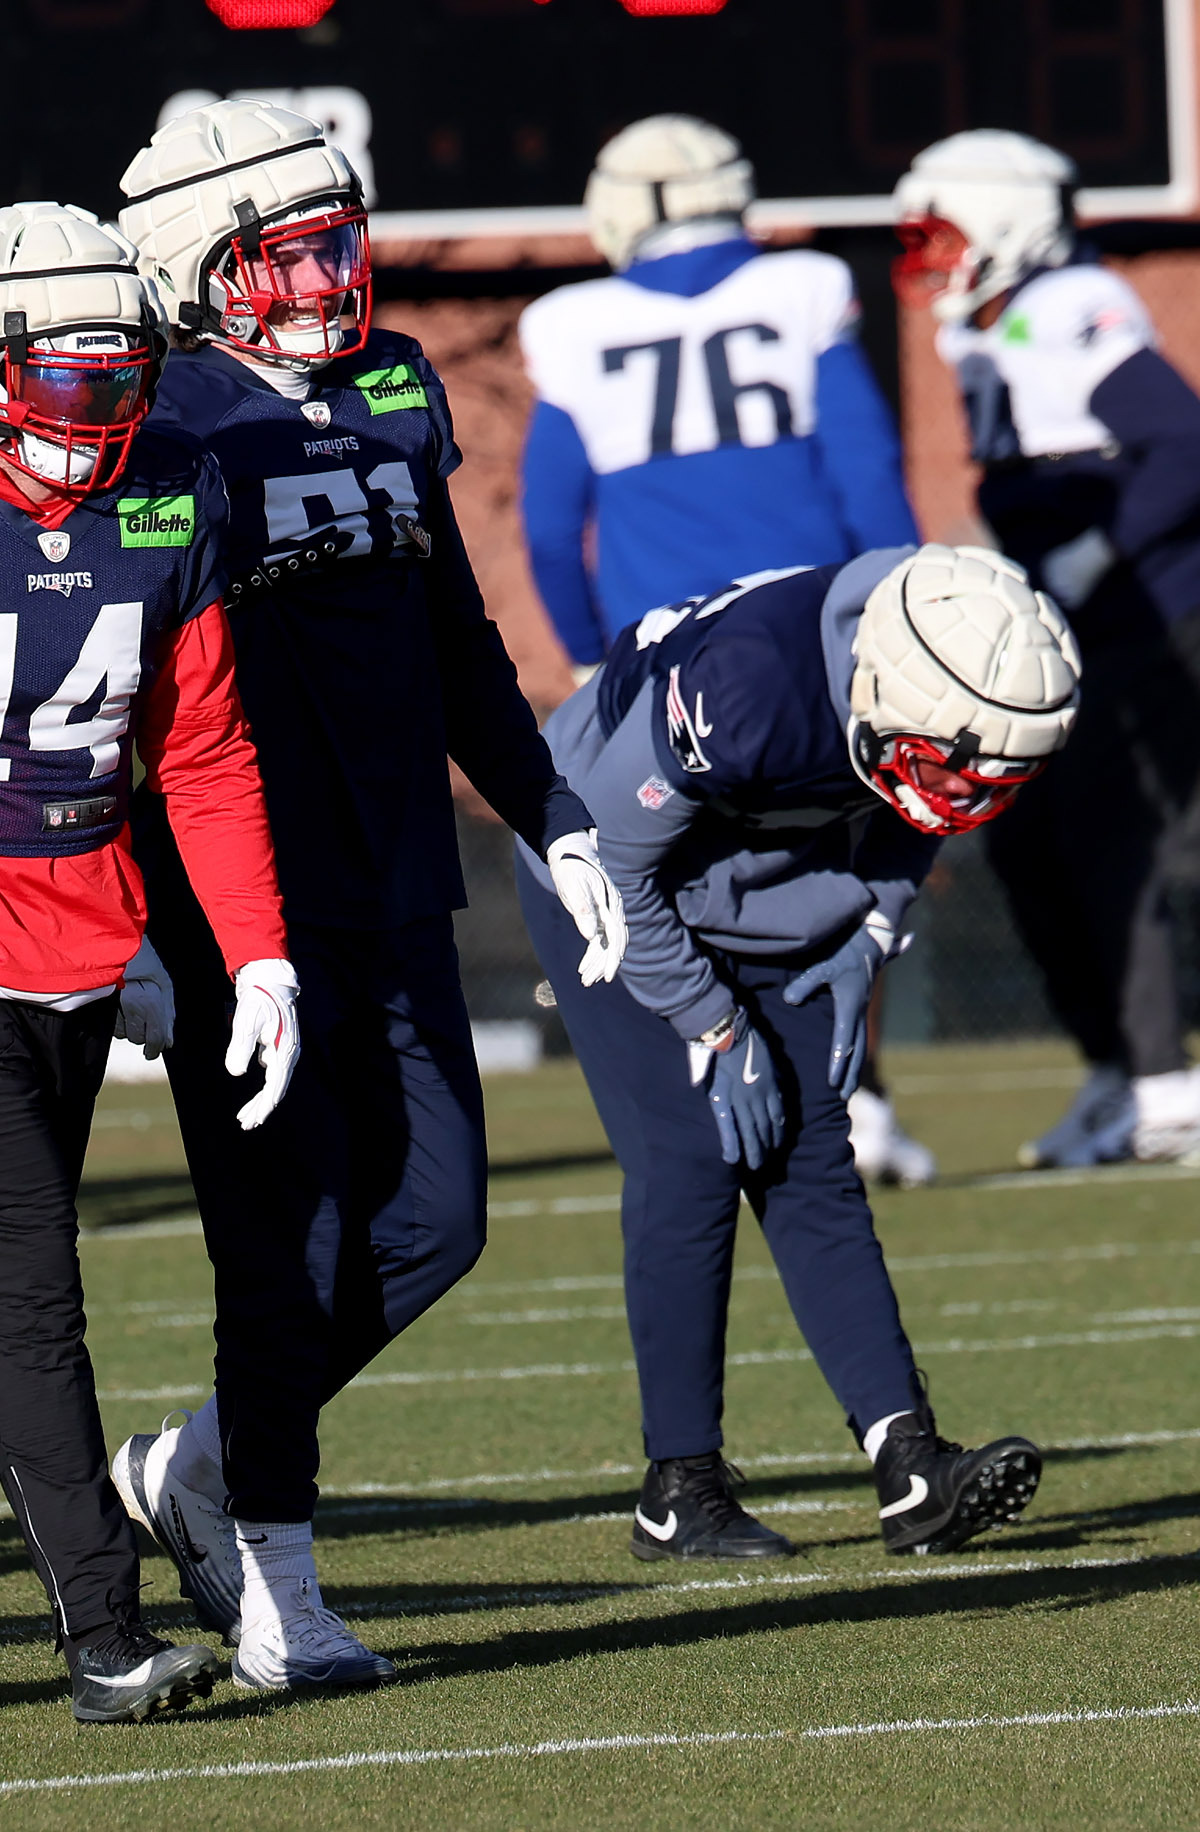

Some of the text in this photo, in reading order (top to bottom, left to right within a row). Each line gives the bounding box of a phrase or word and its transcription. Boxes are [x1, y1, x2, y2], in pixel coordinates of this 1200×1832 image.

[369, 379, 422, 400] Gillette
[603, 323, 793, 457] 76
[303, 436, 360, 458] PATRIOTS
[126, 511, 191, 534] Gillette
[27, 571, 94, 594] PATRIOTS
